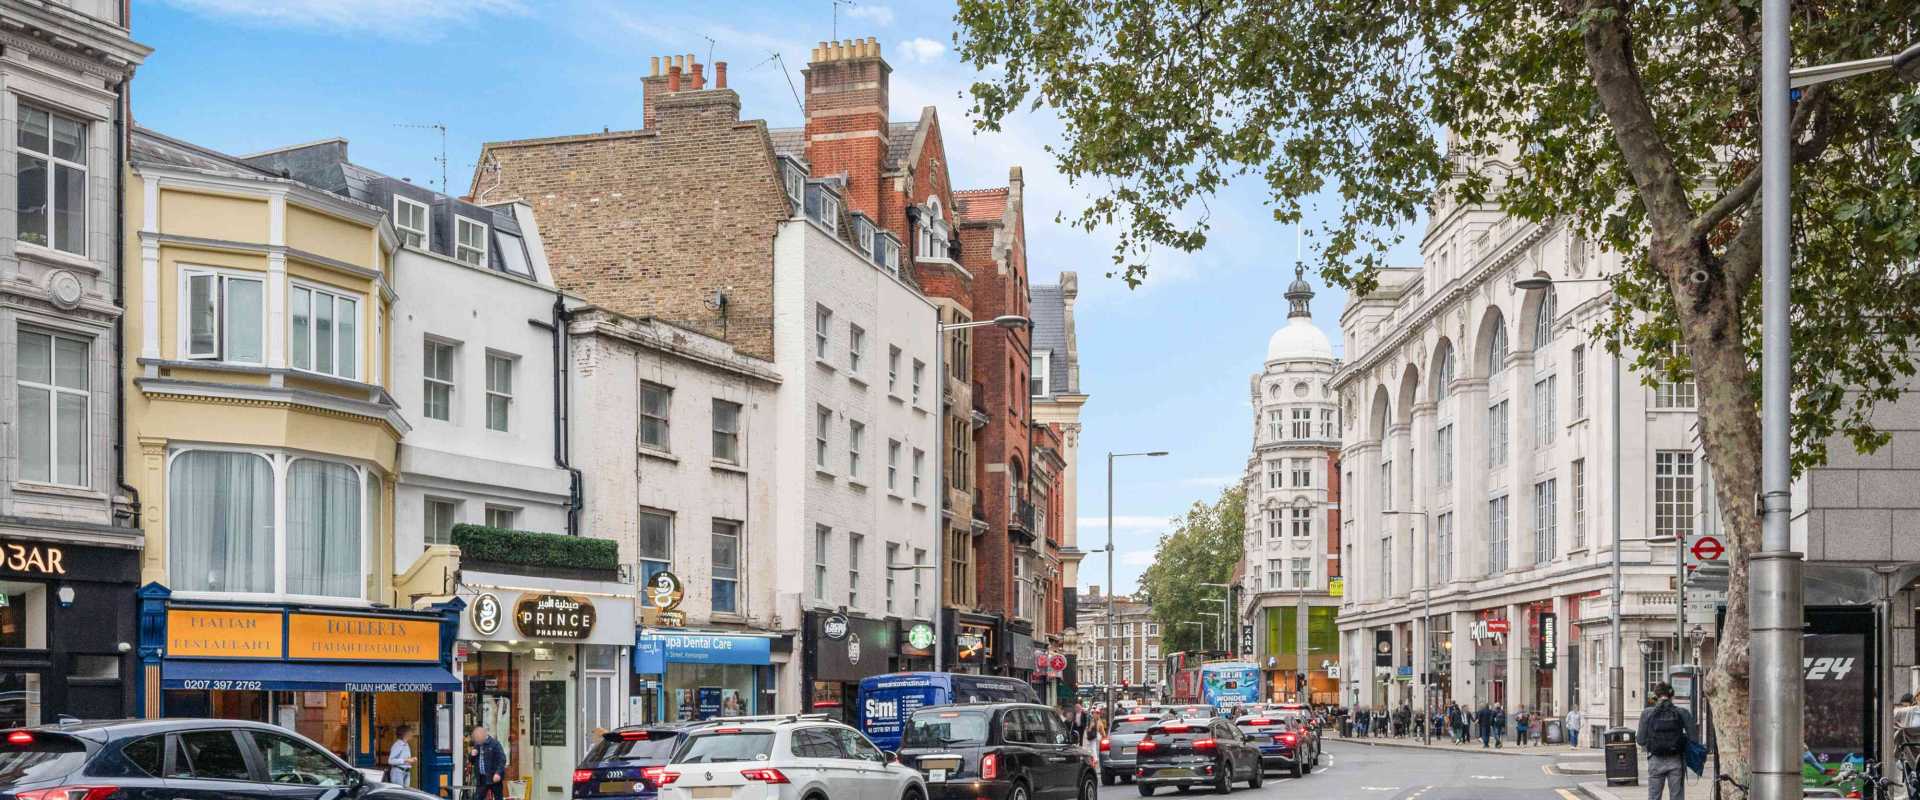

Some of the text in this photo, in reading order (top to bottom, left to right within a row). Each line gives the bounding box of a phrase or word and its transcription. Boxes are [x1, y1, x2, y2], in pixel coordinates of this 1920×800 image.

[0, 543, 66, 574] BAR
[191, 616, 257, 629] ITALIAN
[524, 611, 590, 627] PRINCE
[536, 629, 578, 637] PHARMACY
[1244, 627, 1252, 653] ZARA
[174, 639, 273, 651] RESTAURANT
[683, 635, 711, 649] Dental
[713, 637, 733, 650] Care
[1545, 617, 1554, 664] wagamama
[184, 680, 262, 691] 0207 397 2762
[345, 682, 433, 693] ITALIAN HOME COOKING
